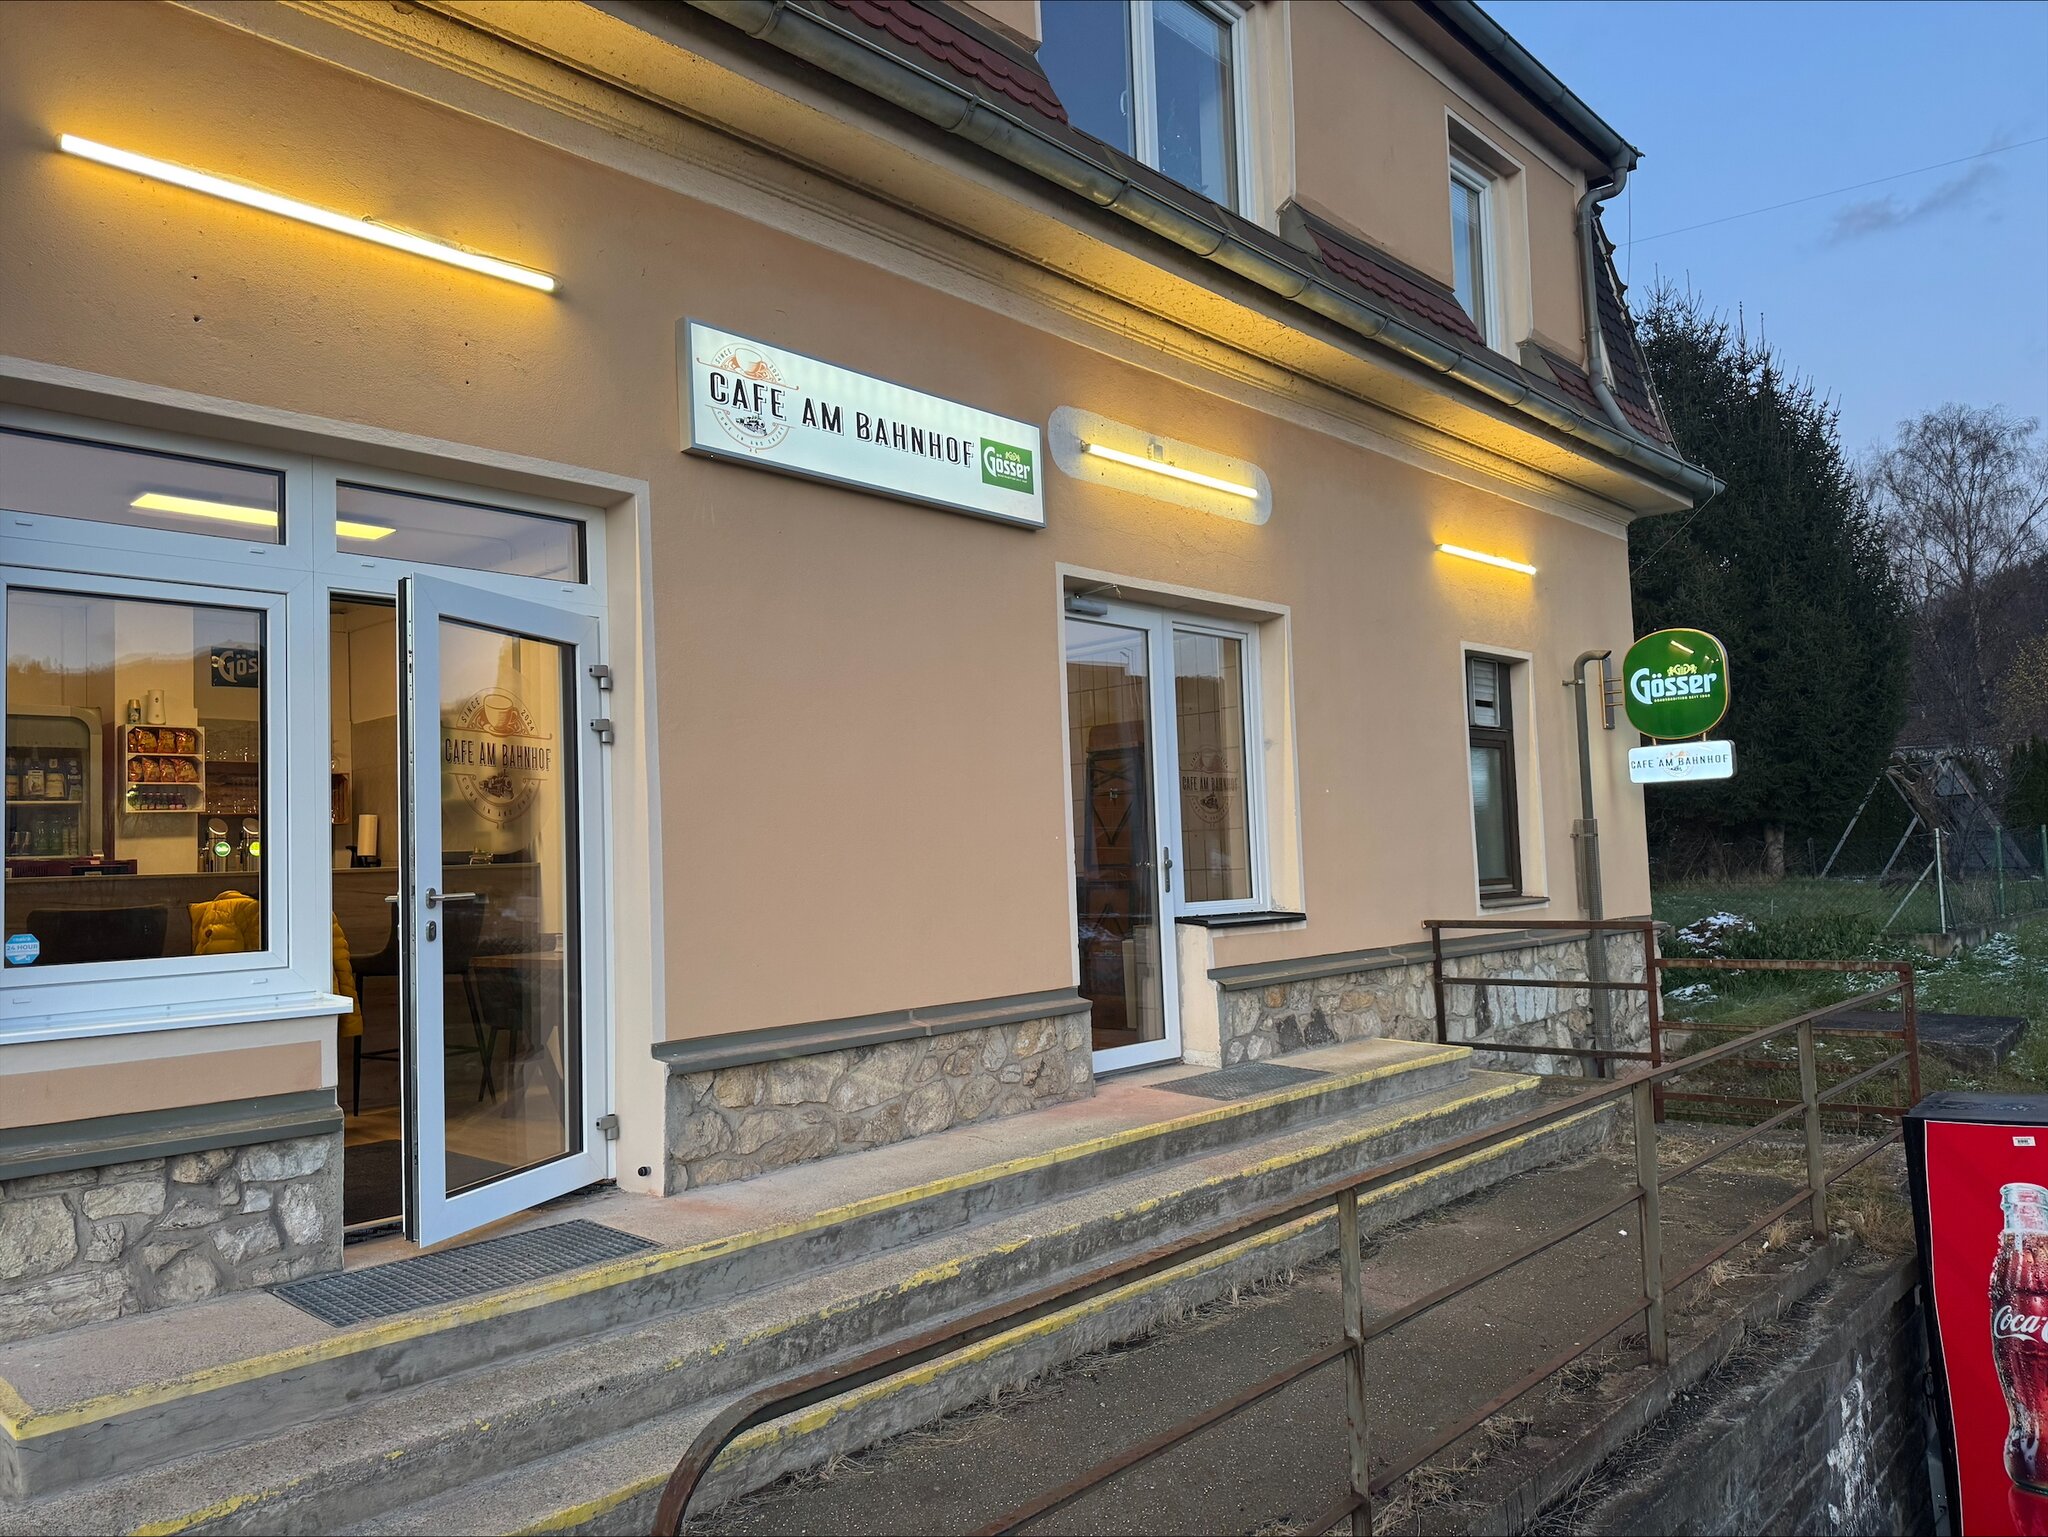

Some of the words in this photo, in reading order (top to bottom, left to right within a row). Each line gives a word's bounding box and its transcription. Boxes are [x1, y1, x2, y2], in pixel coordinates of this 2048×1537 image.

[715, 347, 733, 365] SINCE
[710, 371, 786, 421] CAFE
[801, 397, 845, 436] AM
[856, 411, 975, 468] BAHNHOF
[983, 446, 1030, 480] Gösser
[1630, 667, 1717, 705] Gösser
[462, 696, 481, 723] SINCE
[520, 709, 535, 731] 2024
[445, 738, 474, 766] CAFE
[479, 741, 496, 767] AM
[502, 744, 552, 771] BAHNHOF
[1630, 759, 1654, 770] CAFE
[1658, 757, 1674, 767] AM
[1678, 754, 1729, 766] BAHNHOF
